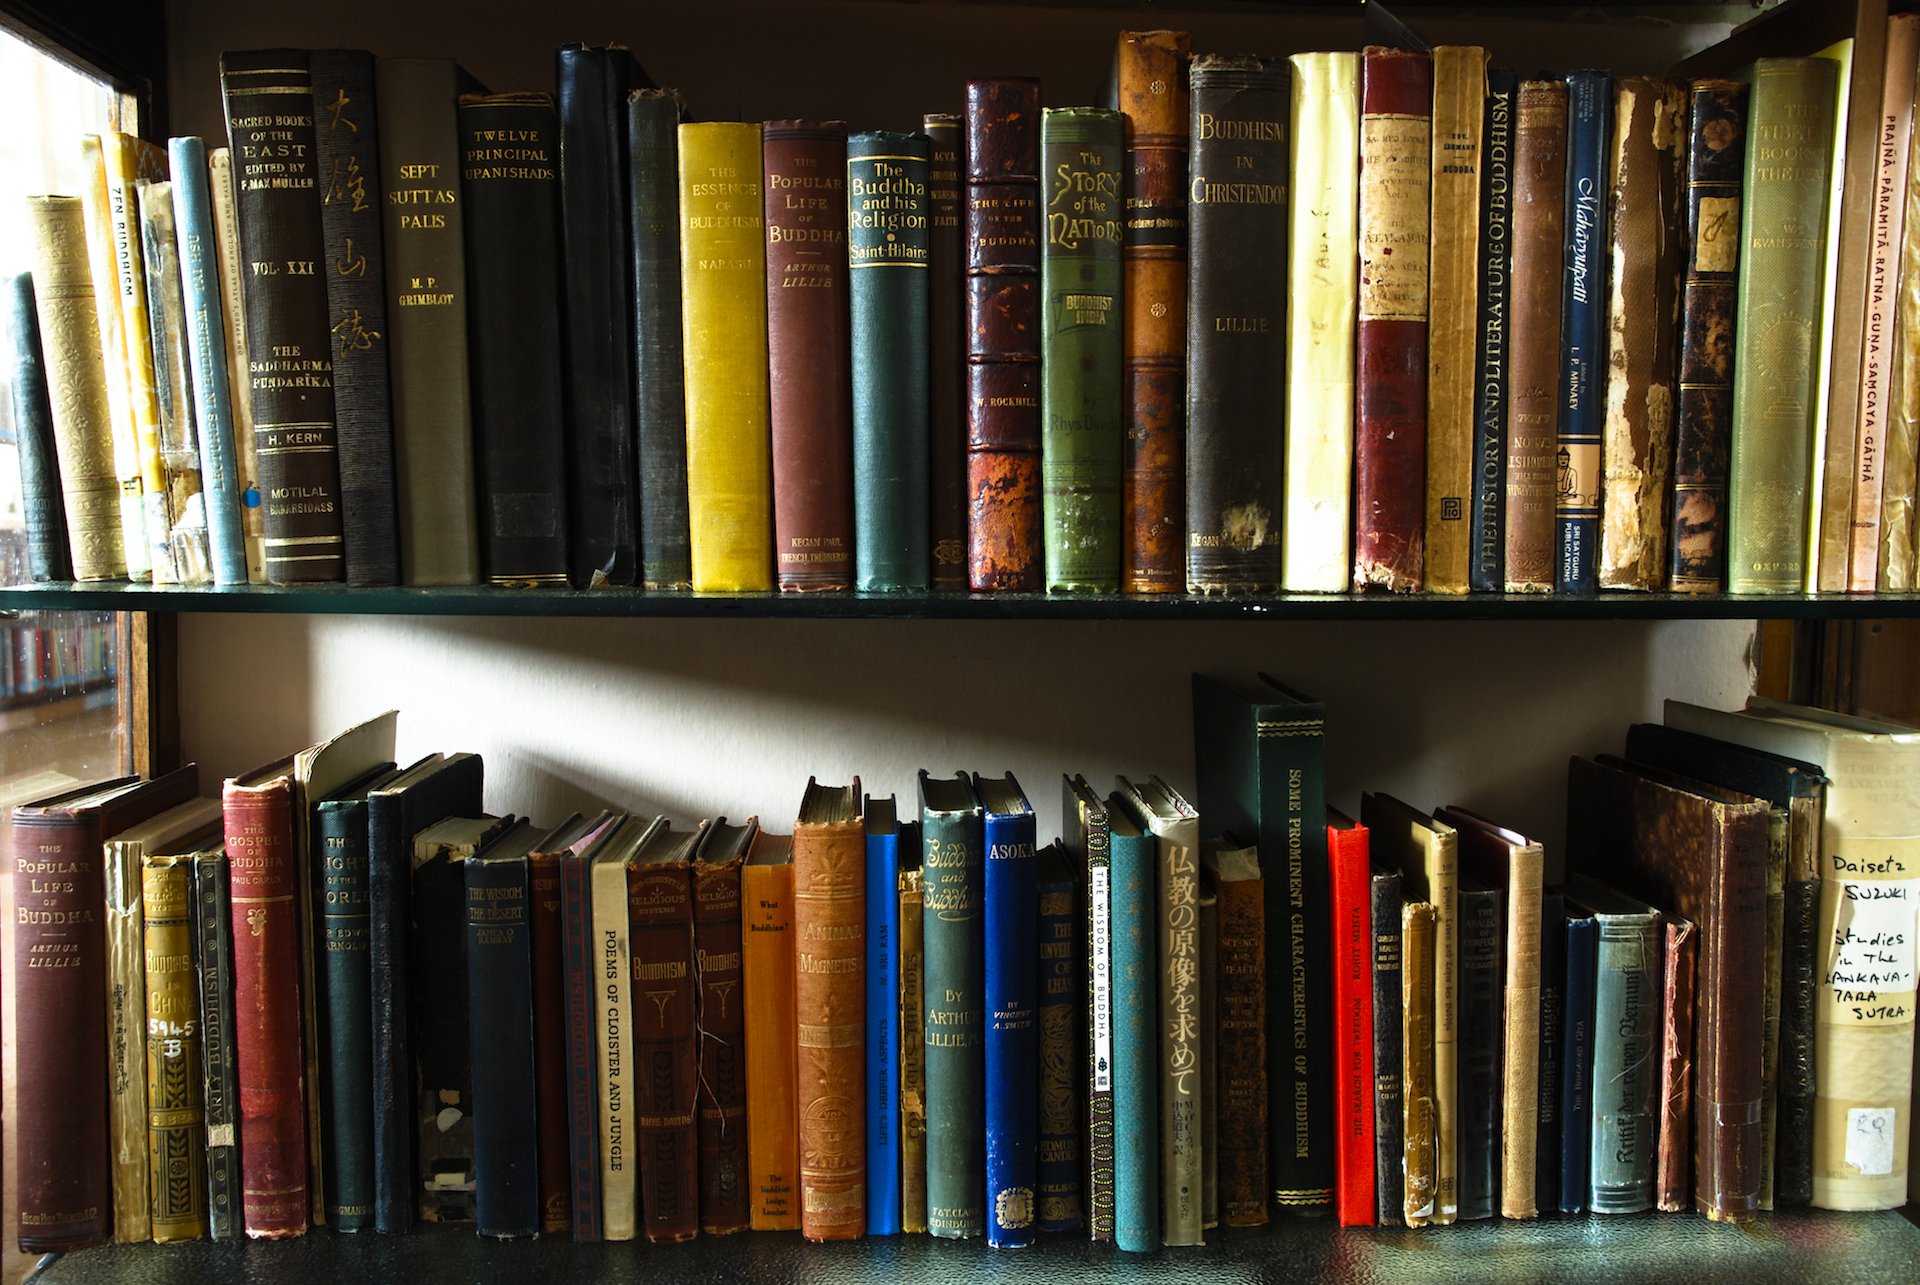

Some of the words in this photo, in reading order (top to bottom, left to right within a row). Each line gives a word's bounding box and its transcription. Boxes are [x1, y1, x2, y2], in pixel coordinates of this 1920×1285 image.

[231, 116, 272, 129] SACRED
[274, 115, 313, 128] BOOKS
[1199, 113, 1284, 141] BUDDHISM
[250, 131, 267, 142] OF
[271, 130, 294, 141] THE
[473, 130, 540, 142] TWELVE
[243, 144, 307, 159] EAST
[467, 149, 549, 162] PRINCIPAL
[1490, 91, 1510, 206] BUDDHISM
[245, 163, 286, 175] EDITED
[289, 163, 306, 174] BY
[794, 158, 817, 167] THE
[873, 162, 904, 177] The
[1235, 156, 1254, 169] IN
[400, 164, 440, 179] SEPT
[464, 167, 556, 181] UPANISHADS
[709, 167, 736, 178] THE
[1757, 167, 1793, 181] THE
[769, 174, 842, 190] POPULAR
[852, 176, 926, 196] Buddha
[389, 190, 456, 205] SUTTAS
[692, 183, 757, 197] ESSENCE
[715, 202, 731, 212] OF
[785, 194, 829, 209] LIFE
[862, 195, 891, 210] and
[894, 195, 918, 210] his
[973, 199, 999, 209] THE
[1002, 199, 1036, 209] LIFE
[1074, 198, 1087, 213] of
[1088, 198, 1108, 213] the
[401, 215, 446, 230] PALIS
[689, 216, 760, 230] BUDDHISM
[798, 215, 814, 223] OF
[850, 210, 928, 232] Religion
[1488, 209, 1506, 238] OF
[225, 222, 233, 261] ENGLAND
[769, 225, 843, 243] BUDDHA
[187, 233, 200, 263] HSU
[979, 236, 1037, 248] BUDDHA
[850, 242, 929, 259] Saint-Hilaire
[116, 222, 133, 296] BUDDHISM
[229, 263, 236, 274] OF
[286, 260, 315, 275] XXI
[784, 263, 832, 273] ARTHUR
[192, 268, 205, 294] TAI
[411, 277, 424, 290] M.
[427, 277, 438, 290] P.
[782, 277, 833, 288] LILLIE
[230, 276, 238, 303] ATLAS
[399, 294, 455, 307] GRIMBLOT
[1066, 293, 1113, 310] BUDDHIST
[1485, 241, 1504, 373] LITERATURE
[231, 304, 240, 337] SPEED'S
[1075, 309, 1107, 325] INDIA
[1215, 317, 1269, 333] LILLIE
[272, 345, 300, 357] THE
[250, 360, 333, 373] SADDHARMA
[1570, 357, 1580, 366] P.
[204, 391, 216, 409] IN
[1484, 381, 1502, 429] AND
[1050, 414, 1082, 437] Rhys
[268, 434, 283, 446] H.
[286, 432, 323, 444] KERN
[206, 413, 225, 492] LECTURES
[271, 486, 328, 500] MOTILAL
[269, 501, 334, 516] BANARSIDASS
[1573, 524, 1581, 541] SRI
[791, 537, 820, 547] KEGAN
[822, 537, 842, 547] PAUL
[1562, 522, 1573, 583] PUBLICATIONS
[1571, 543, 1581, 581] SATGURU
[1752, 562, 1801, 571] OXFORD
[1288, 768, 1303, 812] SOME
[243, 826, 264, 834] THE
[228, 835, 281, 847] GOSPEL
[39, 844, 62, 854] THE
[247, 848, 261, 856] OF
[989, 842, 1036, 861] ASOKA
[17, 857, 92, 874] POPULAR
[230, 856, 284, 870] BUDDHA
[1288, 817, 1304, 909] PROMINENT
[1832, 855, 1906, 873] Daisetz
[231, 874, 251, 885] PAUL
[252, 875, 282, 885] CARUS
[325, 875, 336, 885] OF
[340, 875, 357, 885] THE
[940, 869, 967, 884] and
[1096, 871, 1105, 895] THE
[31, 878, 74, 894] LIFE
[468, 886, 485, 900] THE
[486, 886, 524, 900] WISDOM
[1844, 884, 1907, 901] SUZUKI
[43, 898, 57, 907] OF
[631, 894, 687, 907] RELIGIOUS
[759, 900, 779, 909] What
[18, 906, 94, 925] BUDDHA
[469, 907, 485, 920] THE
[487, 906, 523, 920] DESERT
[639, 906, 676, 916] SYSTEMS
[476, 927, 504, 938] JAMES
[804, 921, 863, 941] ANIMAL
[879, 924, 889, 948] RAM
[1096, 903, 1105, 956] WISDOM
[30, 943, 79, 953] ARTHUR
[605, 930, 618, 979] POEMS
[29, 957, 81, 968] LILLIE
[1351, 947, 1362, 980] ROHIT
[1838, 953, 1853, 967] in
[632, 956, 688, 981] BUDDHISM
[1097, 963, 1106, 979] OF
[1167, 845, 1197, 1096] 仏教の原像を求めて
[1290, 913, 1308, 1050] CHARACTERISTICS
[607, 984, 619, 1003] OF
[1619, 963, 1642, 1039] Vernunft
[1833, 988, 1877, 1003] TARA
[151, 991, 195, 1014] CHINA
[1007, 1001, 1019, 1009] BY
[204, 964, 221, 1065] BUDDHISM
[571, 971, 585, 1068] BUDDHISM
[993, 1009, 1031, 1020] VINCENT
[1097, 986, 1107, 1040] BUDDHA
[607, 1008, 620, 1079] CLOISTER
[879, 1017, 888, 1064] ASPECTS
[1294, 1054, 1308, 1075] OF
[1352, 1050, 1363, 1071] FOR
[1622, 1044, 1636, 1087] reinen
[609, 1082, 622, 1112] AND
[1352, 1074, 1364, 1114] SEARCH
[1621, 1088, 1635, 1117] der
[1294, 1080, 1310, 1160] BUDDHISM
[1353, 1118, 1364, 1137] THE
[610, 1115, 623, 1172] JUNGLE
[768, 1174, 782, 1183] The
